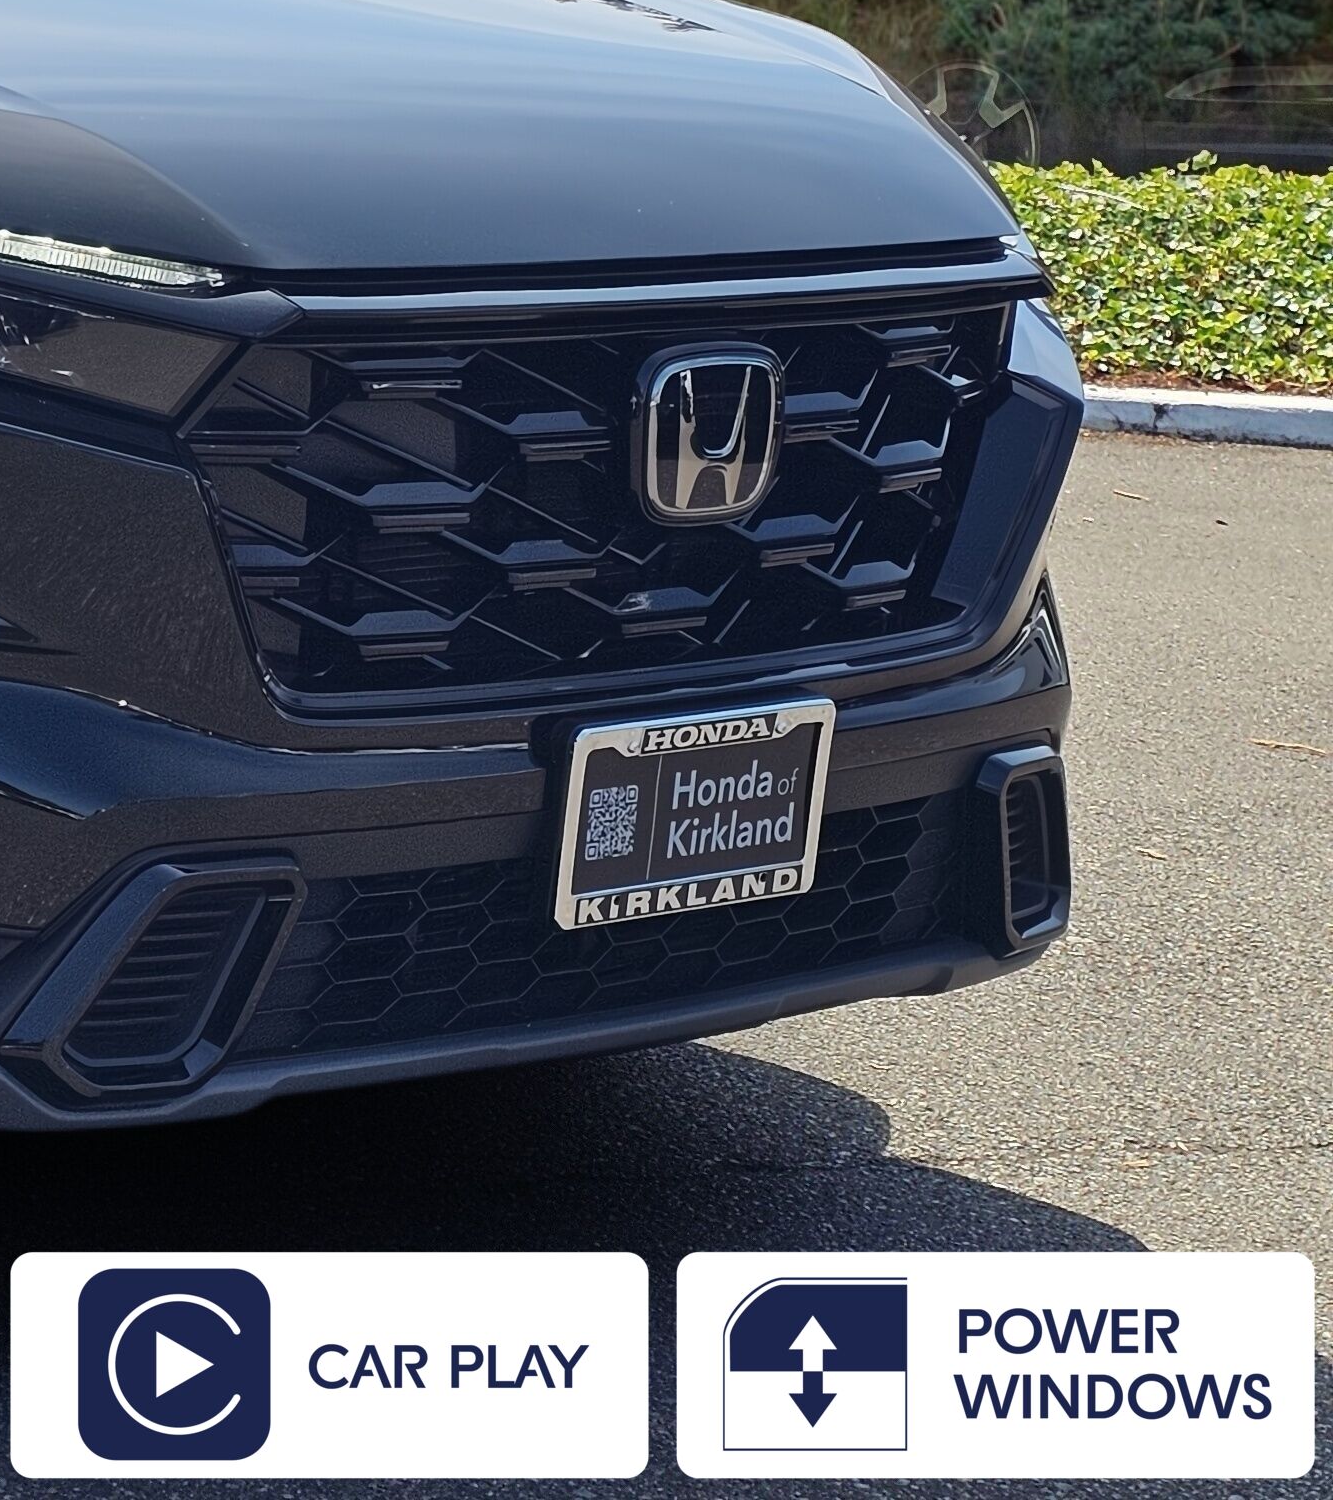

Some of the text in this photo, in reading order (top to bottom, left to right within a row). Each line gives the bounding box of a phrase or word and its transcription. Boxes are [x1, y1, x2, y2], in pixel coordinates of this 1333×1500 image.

[644, 718, 772, 751] HONDA
[672, 760, 799, 810] Honda of
[666, 802, 794, 858] Kirkland
[578, 869, 798, 923] KIRKLAND
